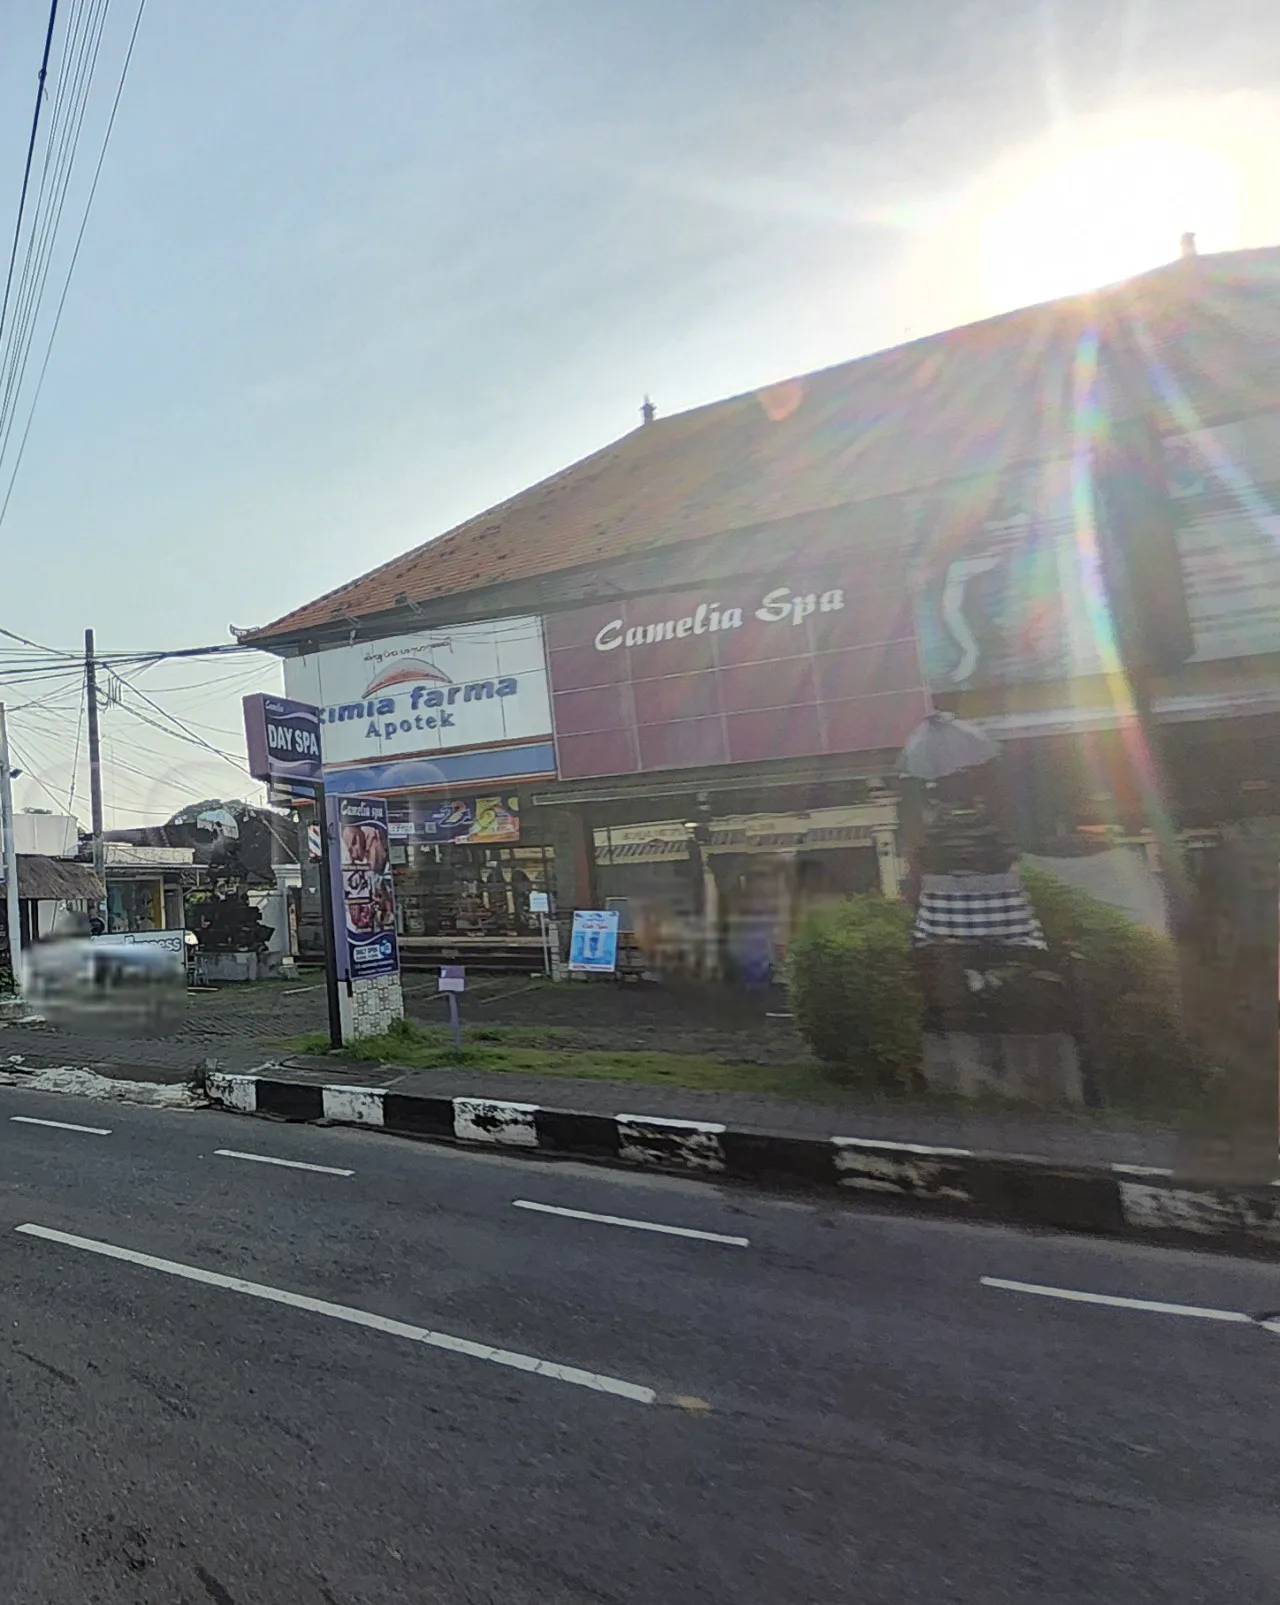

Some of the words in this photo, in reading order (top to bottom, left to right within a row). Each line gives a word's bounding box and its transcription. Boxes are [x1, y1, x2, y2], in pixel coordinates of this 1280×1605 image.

[594, 602, 743, 651] Camelia
[755, 587, 845, 626] Spa
[410, 676, 518, 710] farma
[267, 723, 293, 751] DAY
[294, 729, 319, 756] SPA
[365, 709, 456, 739] Apotek
